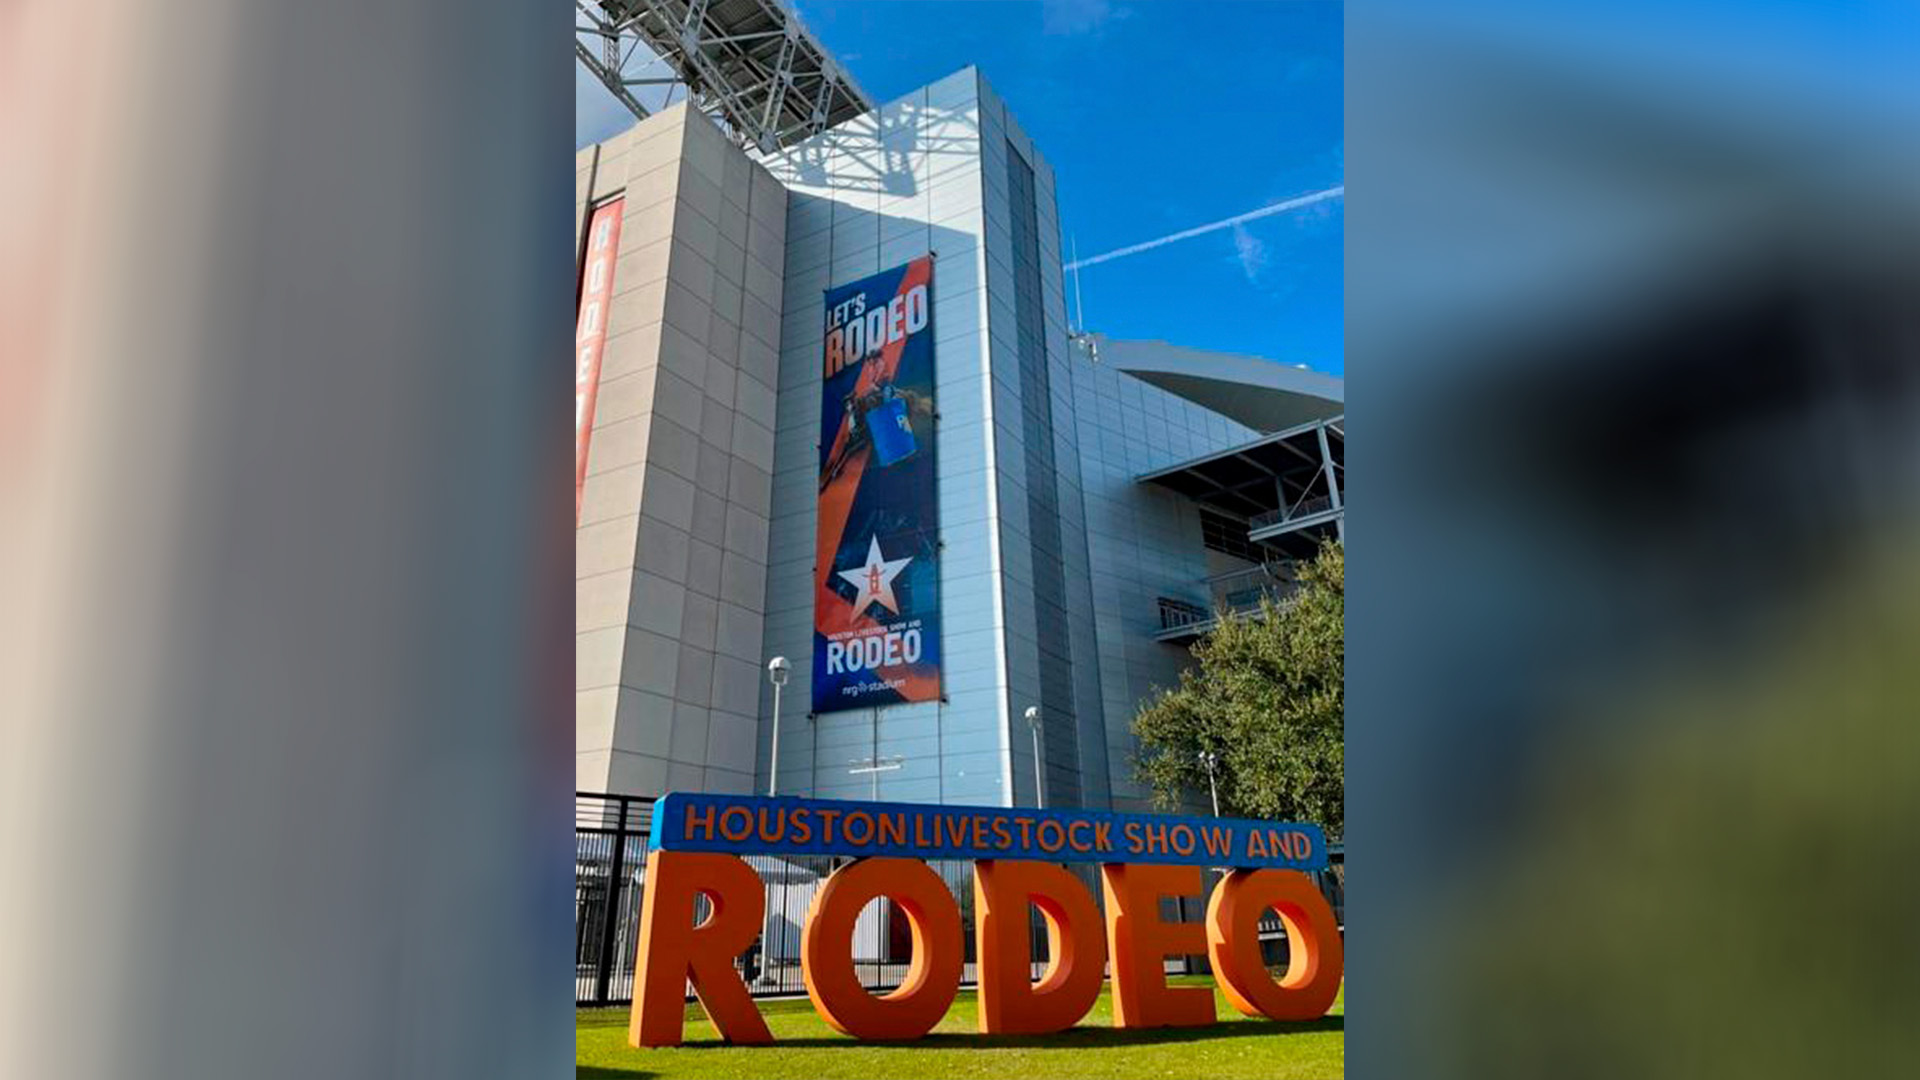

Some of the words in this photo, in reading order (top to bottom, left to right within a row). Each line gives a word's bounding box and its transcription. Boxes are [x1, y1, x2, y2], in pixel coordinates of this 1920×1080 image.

[825, 284, 928, 379] RODEO
[827, 292, 866, 328] LET'S
[908, 619, 922, 629] AND
[827, 629, 921, 675] RODEO
[842, 686, 858, 697] nrg
[684, 804, 910, 847] HOUSTON
[915, 815, 1113, 853] LIVESTOCK
[1124, 822, 1232, 857] SHOW
[1246, 829, 1312, 861] AND
[629, 851, 1344, 1048] RODEO
